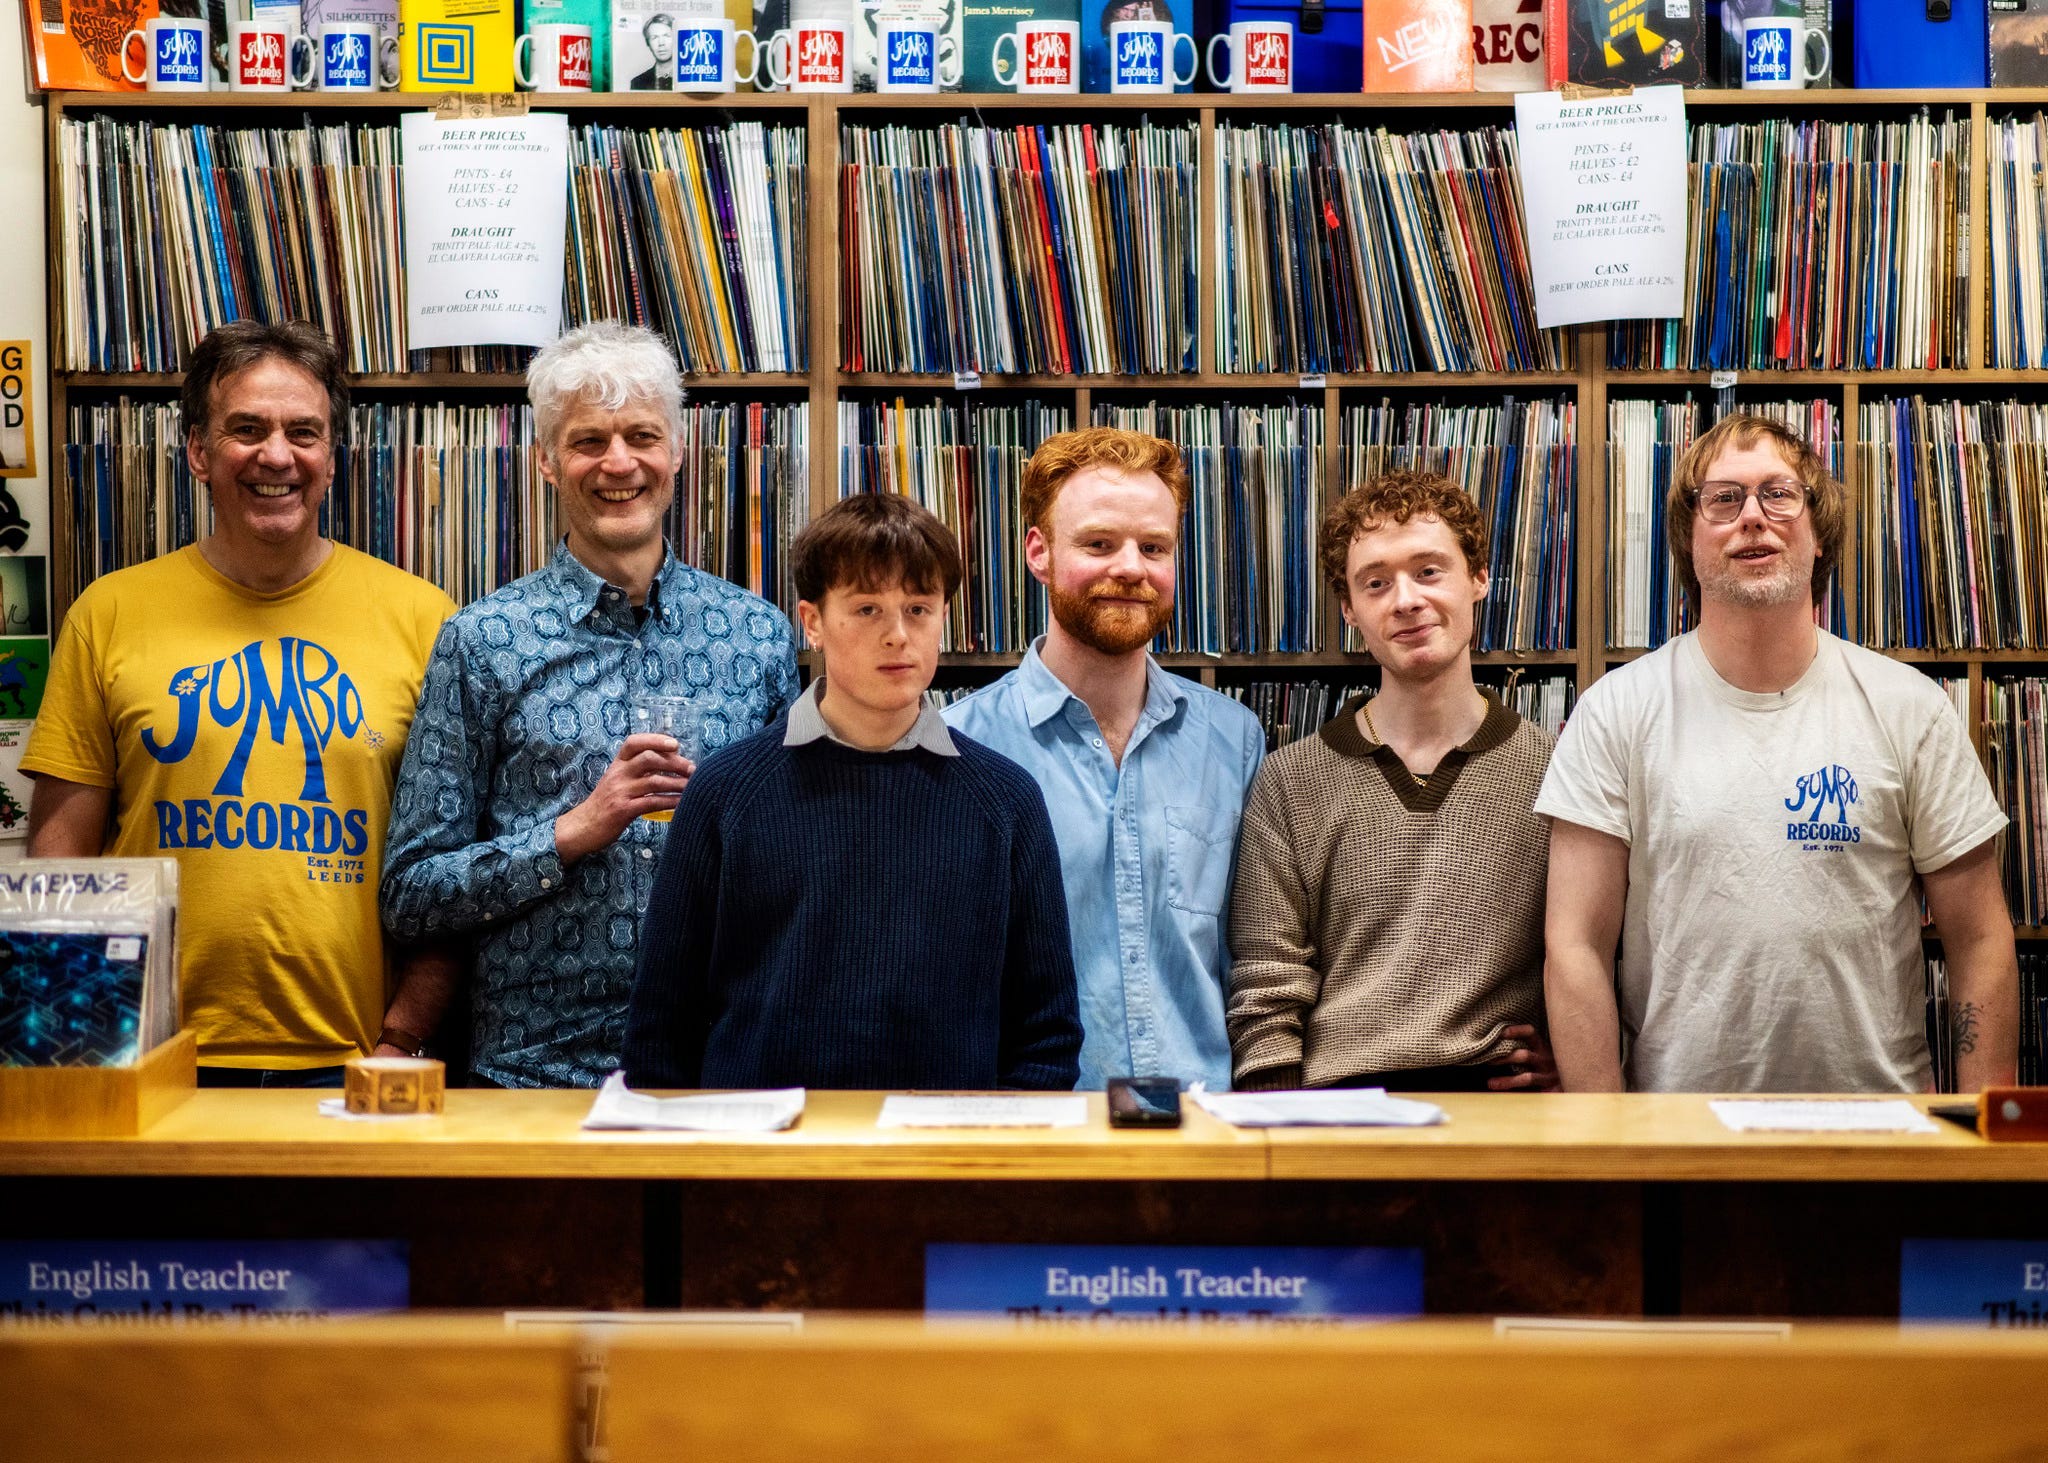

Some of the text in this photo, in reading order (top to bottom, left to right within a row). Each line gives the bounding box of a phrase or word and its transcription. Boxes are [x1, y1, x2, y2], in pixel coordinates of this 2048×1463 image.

[326, 12, 396, 22] SILHOUETTES
[964, 6, 1034, 17] James Morrissey
[160, 31, 198, 64] JUMBO
[242, 34, 281, 68] JUMBO
[680, 32, 717, 64] JUMBO
[800, 33, 838, 66] JUMBO
[890, 34, 929, 67] JUMBO
[1028, 34, 1066, 68] JUMBO
[1120, 34, 1158, 68] JUMBO
[1472, 22, 1545, 66] REC
[1748, 31, 1785, 66] JUMBO
[328, 36, 365, 69] JUMBO
[1248, 36, 1285, 68] JUMBO
[161, 64, 198, 75] RECORDS
[244, 68, 282, 78] RECORDS
[328, 68, 367, 79] RECORDS
[680, 64, 718, 75] RECORDS
[802, 66, 840, 76] RECORDS
[892, 67, 930, 77] RECORDS
[1029, 67, 1068, 78] RECORDS
[1121, 67, 1159, 78] RECORDS
[1250, 67, 1286, 78] RECORDS
[1749, 64, 1786, 74] RECORDS
[1560, 104, 1643, 119] BEER PRICES
[1562, 120, 1588, 129] TOKEN
[1603, 118, 1618, 126] THE
[1620, 116, 1660, 124] COUNTER
[442, 130, 526, 142] BEER PRICES
[1574, 143, 1610, 156] PINTS
[1620, 142, 1632, 152] £4
[1568, 157, 1616, 171] HALVES
[1626, 156, 1640, 166] £2
[454, 168, 489, 179] PINTS
[500, 168, 513, 179] £4
[1578, 173, 1610, 184] CANS
[1620, 171, 1634, 182] £4
[448, 184, 495, 194] HALVES
[504, 184, 519, 194] £2
[455, 198, 488, 208] CANS
[498, 198, 511, 208] £4
[1576, 200, 1641, 214] DRAUGHT
[1556, 218, 1592, 229] TRINITY
[1594, 216, 1618, 225] PALE
[1620, 214, 1638, 224] ALE
[451, 228, 516, 237] DRAUGHT
[1552, 232, 1564, 241] EL
[1566, 228, 1616, 240] CALAVERA
[1618, 226, 1650, 235] LAGER
[432, 242, 466, 251] TRINITY
[468, 242, 492, 250] PALE
[494, 242, 512, 250] ALE
[428, 254, 439, 264] EL
[441, 254, 488, 262] CALAVERA
[491, 254, 522, 262] LAGER
[1594, 263, 1630, 276] CANS
[1549, 283, 1574, 294] BREW
[1576, 278, 1610, 290] ORDER
[1612, 277, 1634, 286] PALE
[1638, 276, 1655, 286] ALE
[466, 289, 500, 300] CANS
[421, 305, 445, 315] BREW
[446, 304, 478, 313] ORDER
[481, 304, 504, 312] PALE
[506, 304, 524, 312] ALE
[141, 636, 370, 804] JUMBO
[1784, 764, 1859, 824] JUMBO
[154, 799, 368, 856] RECORDS
[1787, 823, 1860, 843] RECORDS
[307, 856, 364, 870] Est. 1971
[31, 872, 129, 894] RELEASE
[308, 870, 365, 884] LEEDS
[28, 1262, 291, 1298] English Teacher
[1046, 1267, 1308, 1306] English Teacher
